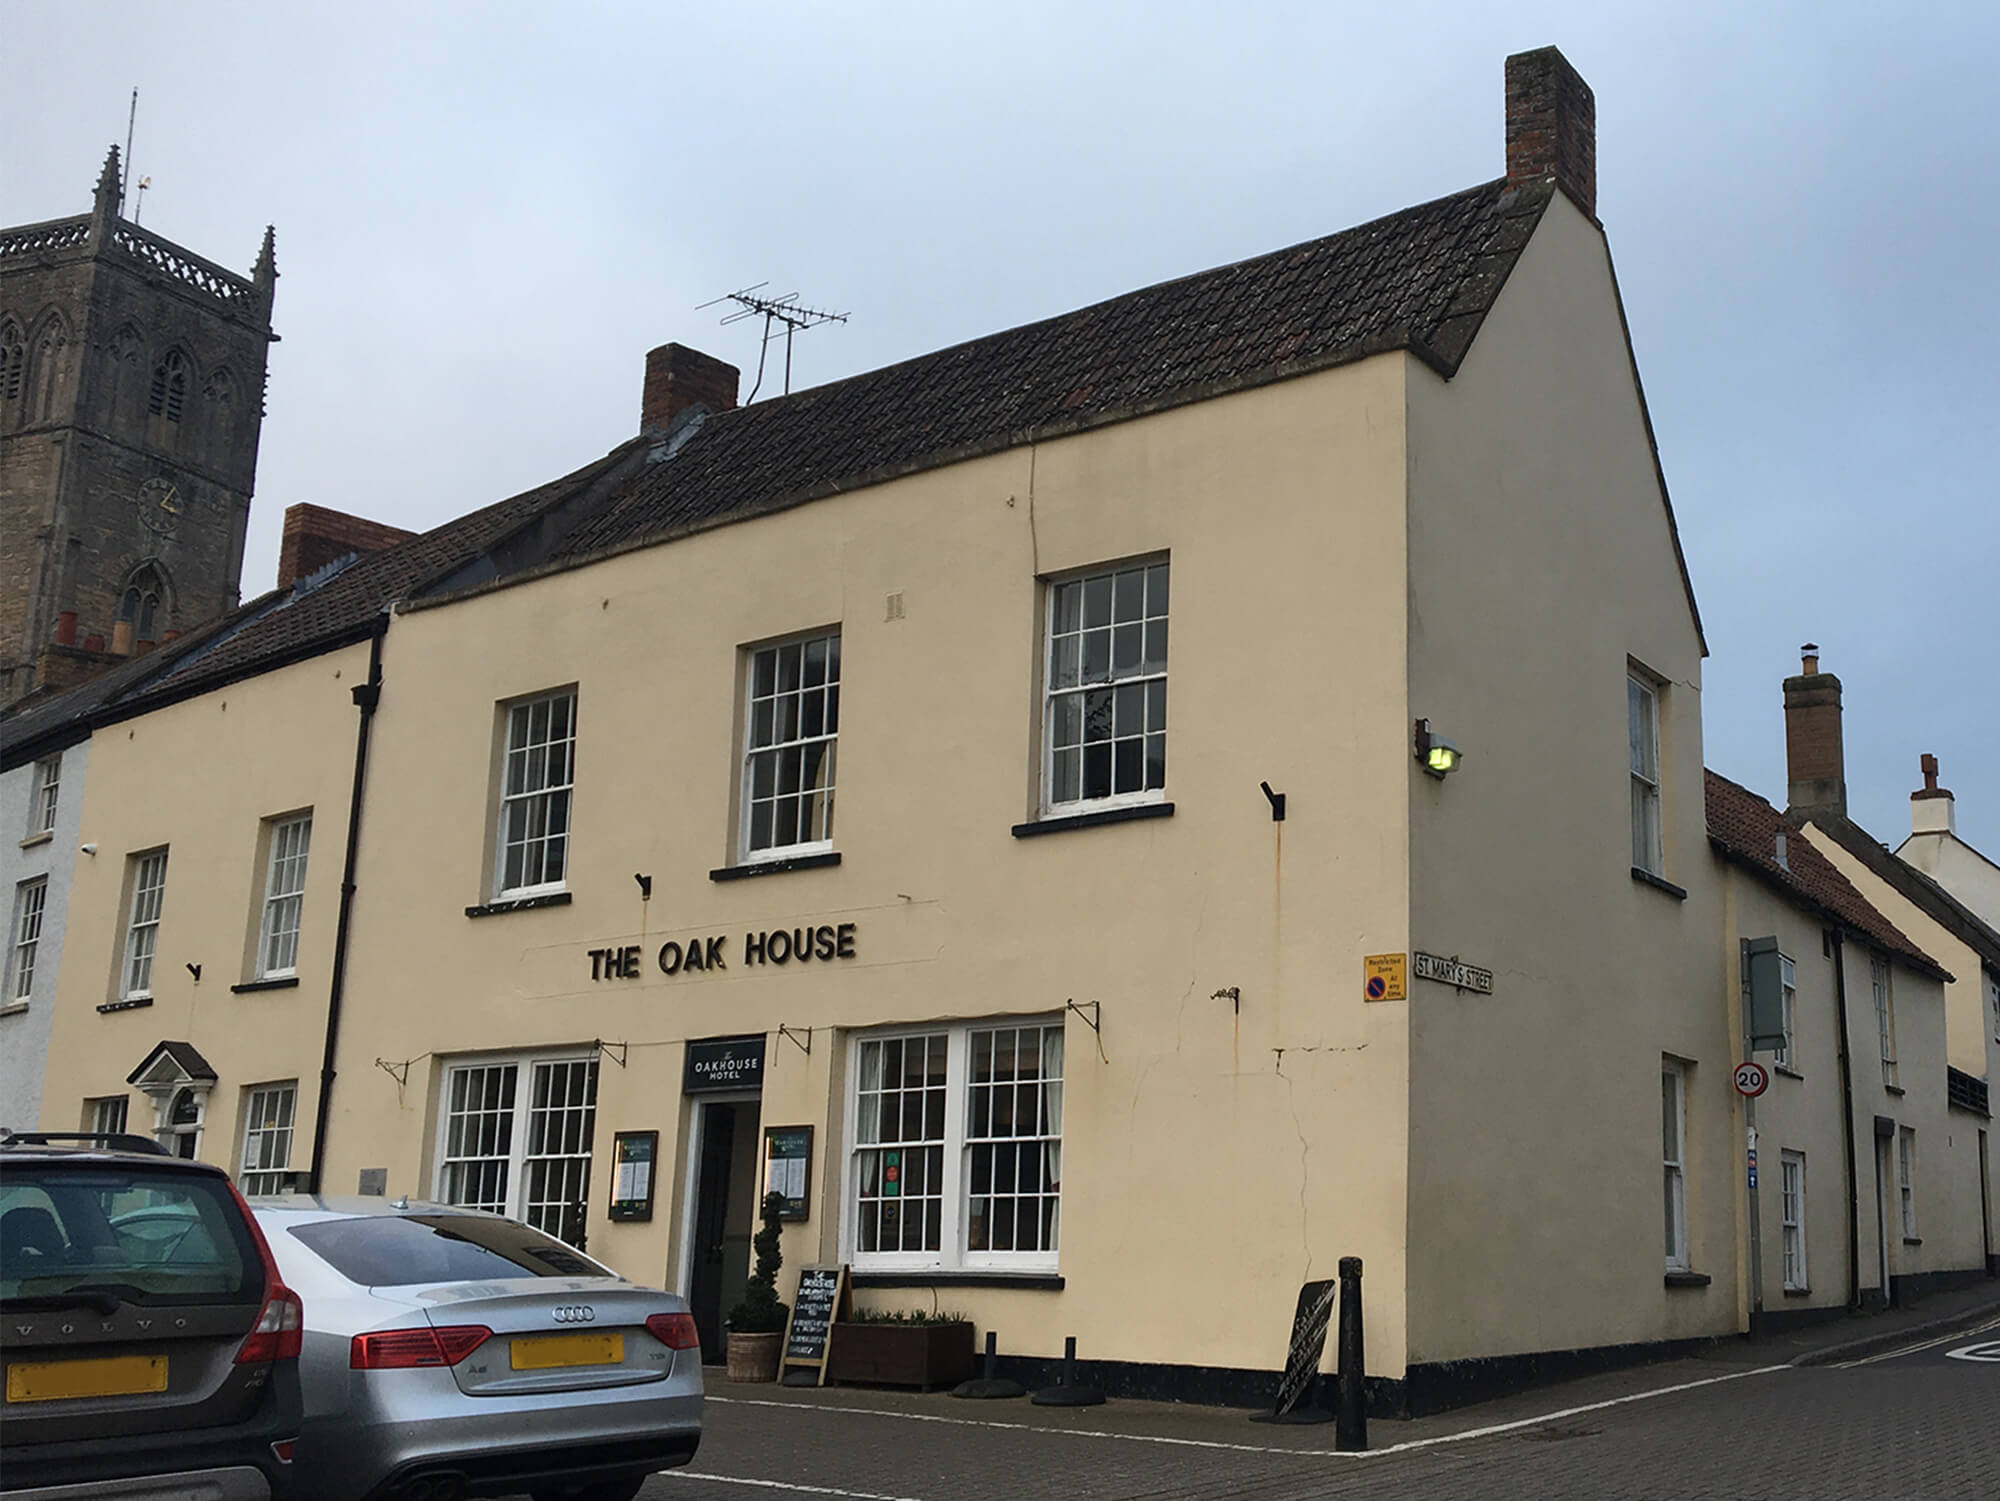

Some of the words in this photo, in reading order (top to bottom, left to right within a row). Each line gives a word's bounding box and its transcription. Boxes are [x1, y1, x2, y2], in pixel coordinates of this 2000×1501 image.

[587, 946, 641, 981] THE
[658, 936, 727, 976] OAK
[744, 922, 857, 966] HOUSE
[695, 1058, 758, 1073] OAKHOUSE
[709, 1070, 741, 1081] HOTEL
[1738, 1072, 1761, 1087] 20
[16, 1317, 187, 1336] VOLVO
